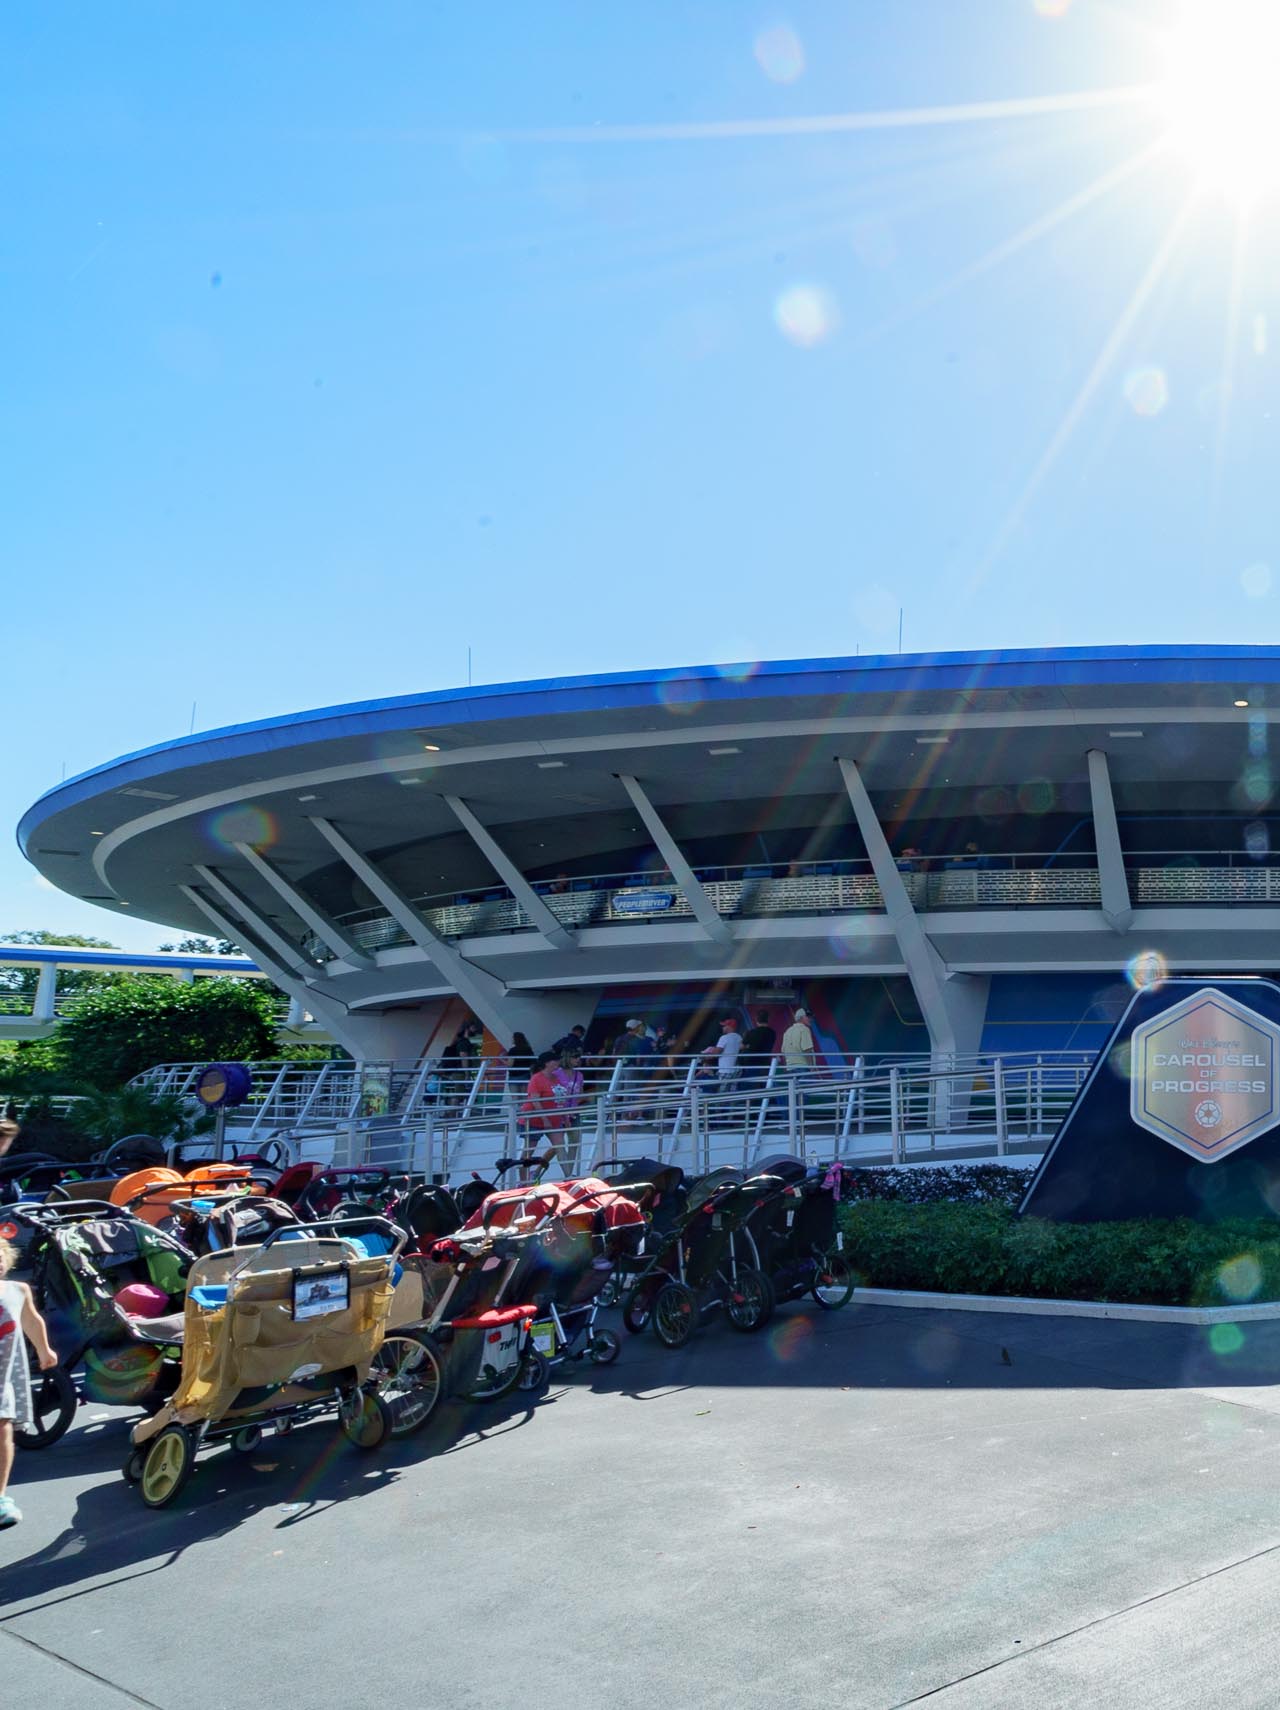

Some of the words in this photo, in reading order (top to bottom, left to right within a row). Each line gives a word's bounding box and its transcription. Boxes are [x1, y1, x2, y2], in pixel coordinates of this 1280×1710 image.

[1152, 1054, 1266, 1067] CAROUSEL
[1200, 1070, 1217, 1078] OF
[1151, 1081, 1266, 1093] PROGRESS
